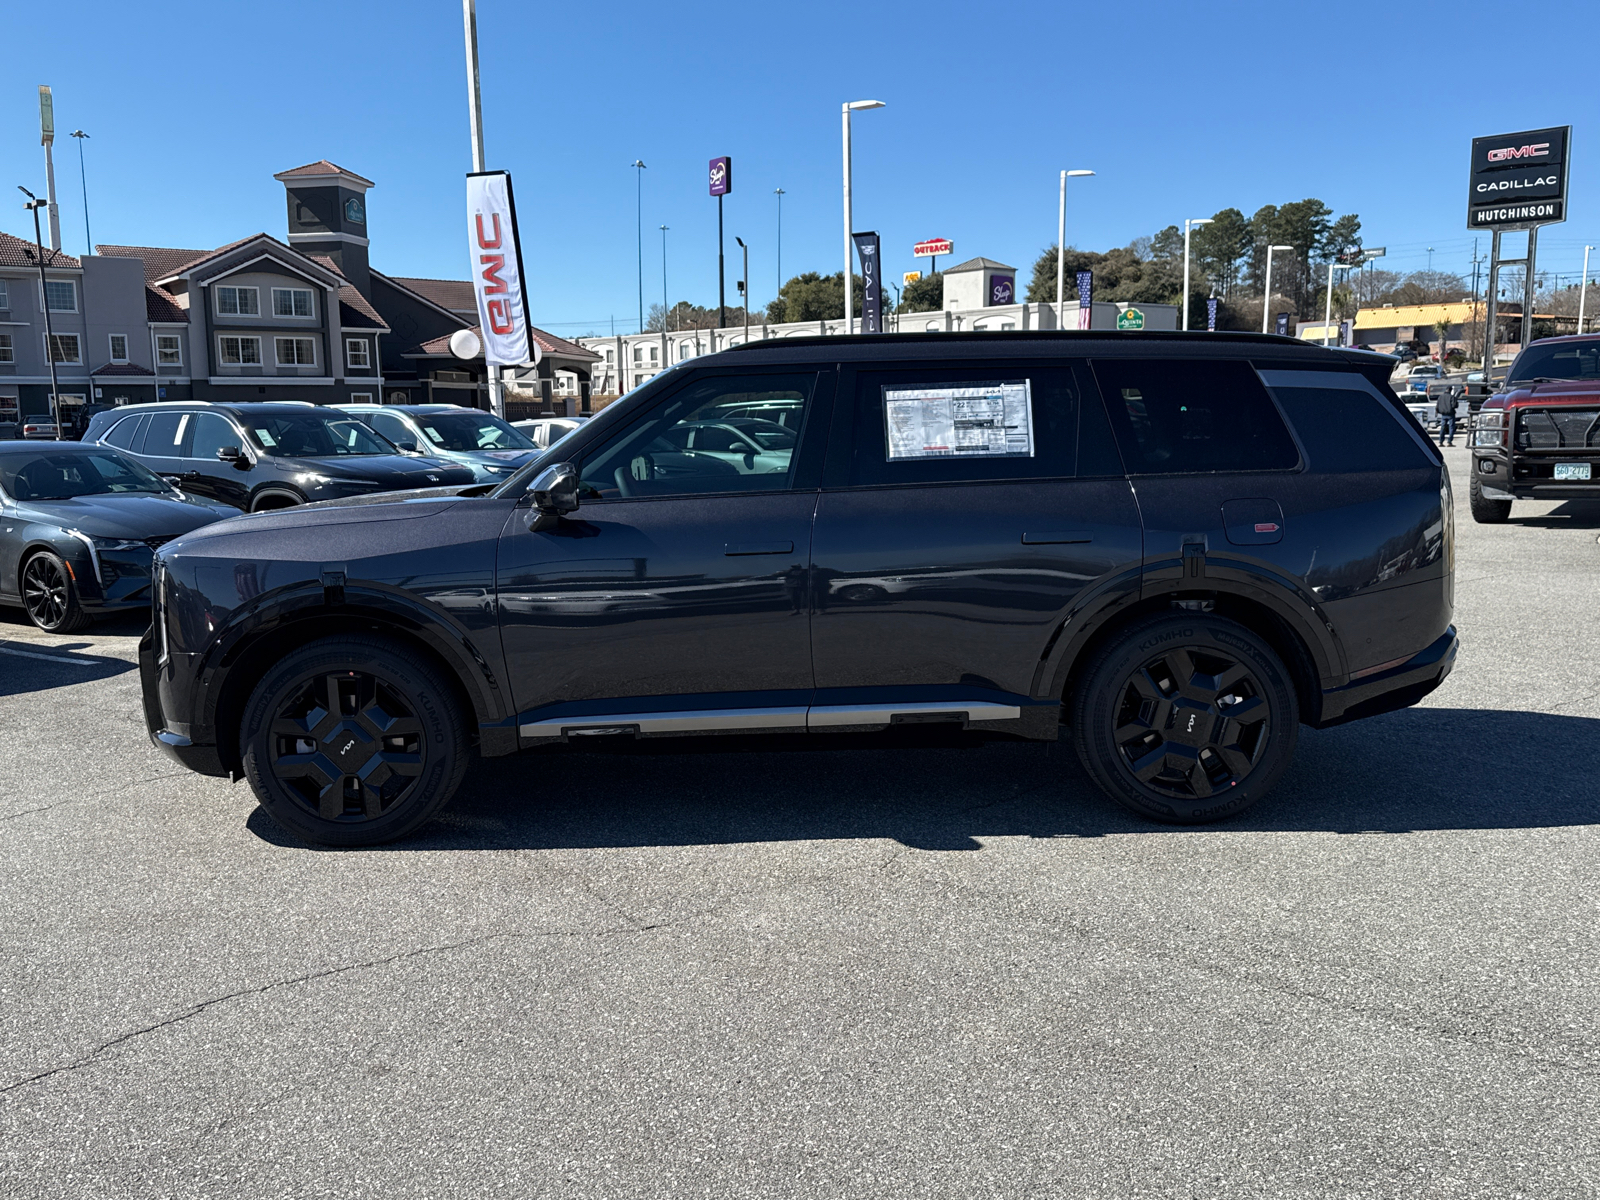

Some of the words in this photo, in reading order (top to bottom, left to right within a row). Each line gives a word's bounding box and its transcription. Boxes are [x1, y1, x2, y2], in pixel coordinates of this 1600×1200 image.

[1488, 143, 1550, 162] GMC
[1477, 176, 1557, 192] CADILLAC
[1478, 205, 1554, 221] HUTCHINSON
[914, 243, 950, 255] OUTBACK
[1138, 628, 1194, 652] KUMHO
[417, 690, 444, 744] KUMHO
[1191, 793, 1248, 818] KUMHO
